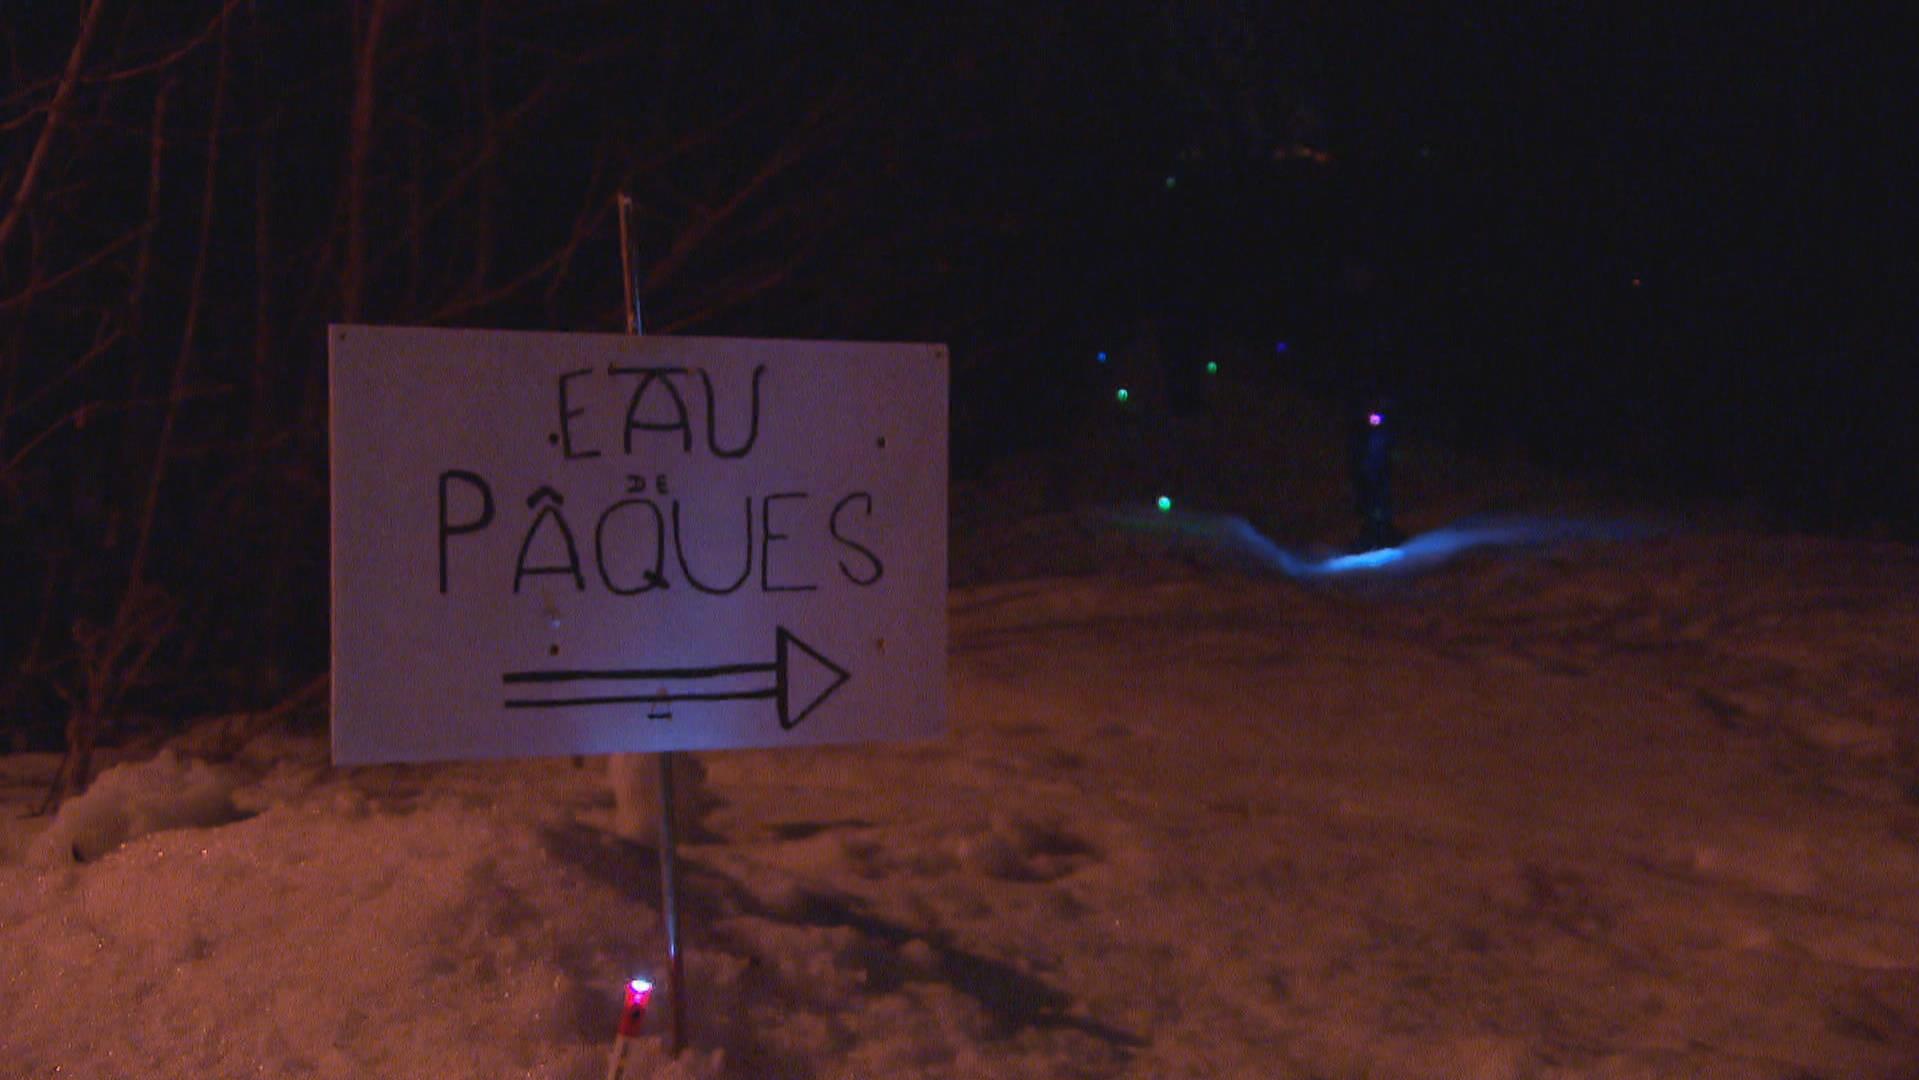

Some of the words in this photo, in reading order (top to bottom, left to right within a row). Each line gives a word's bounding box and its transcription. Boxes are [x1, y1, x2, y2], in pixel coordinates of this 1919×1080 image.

[558, 364, 766, 460] EAU
[626, 474, 669, 494] DE
[437, 469, 884, 596] PÂQUES
